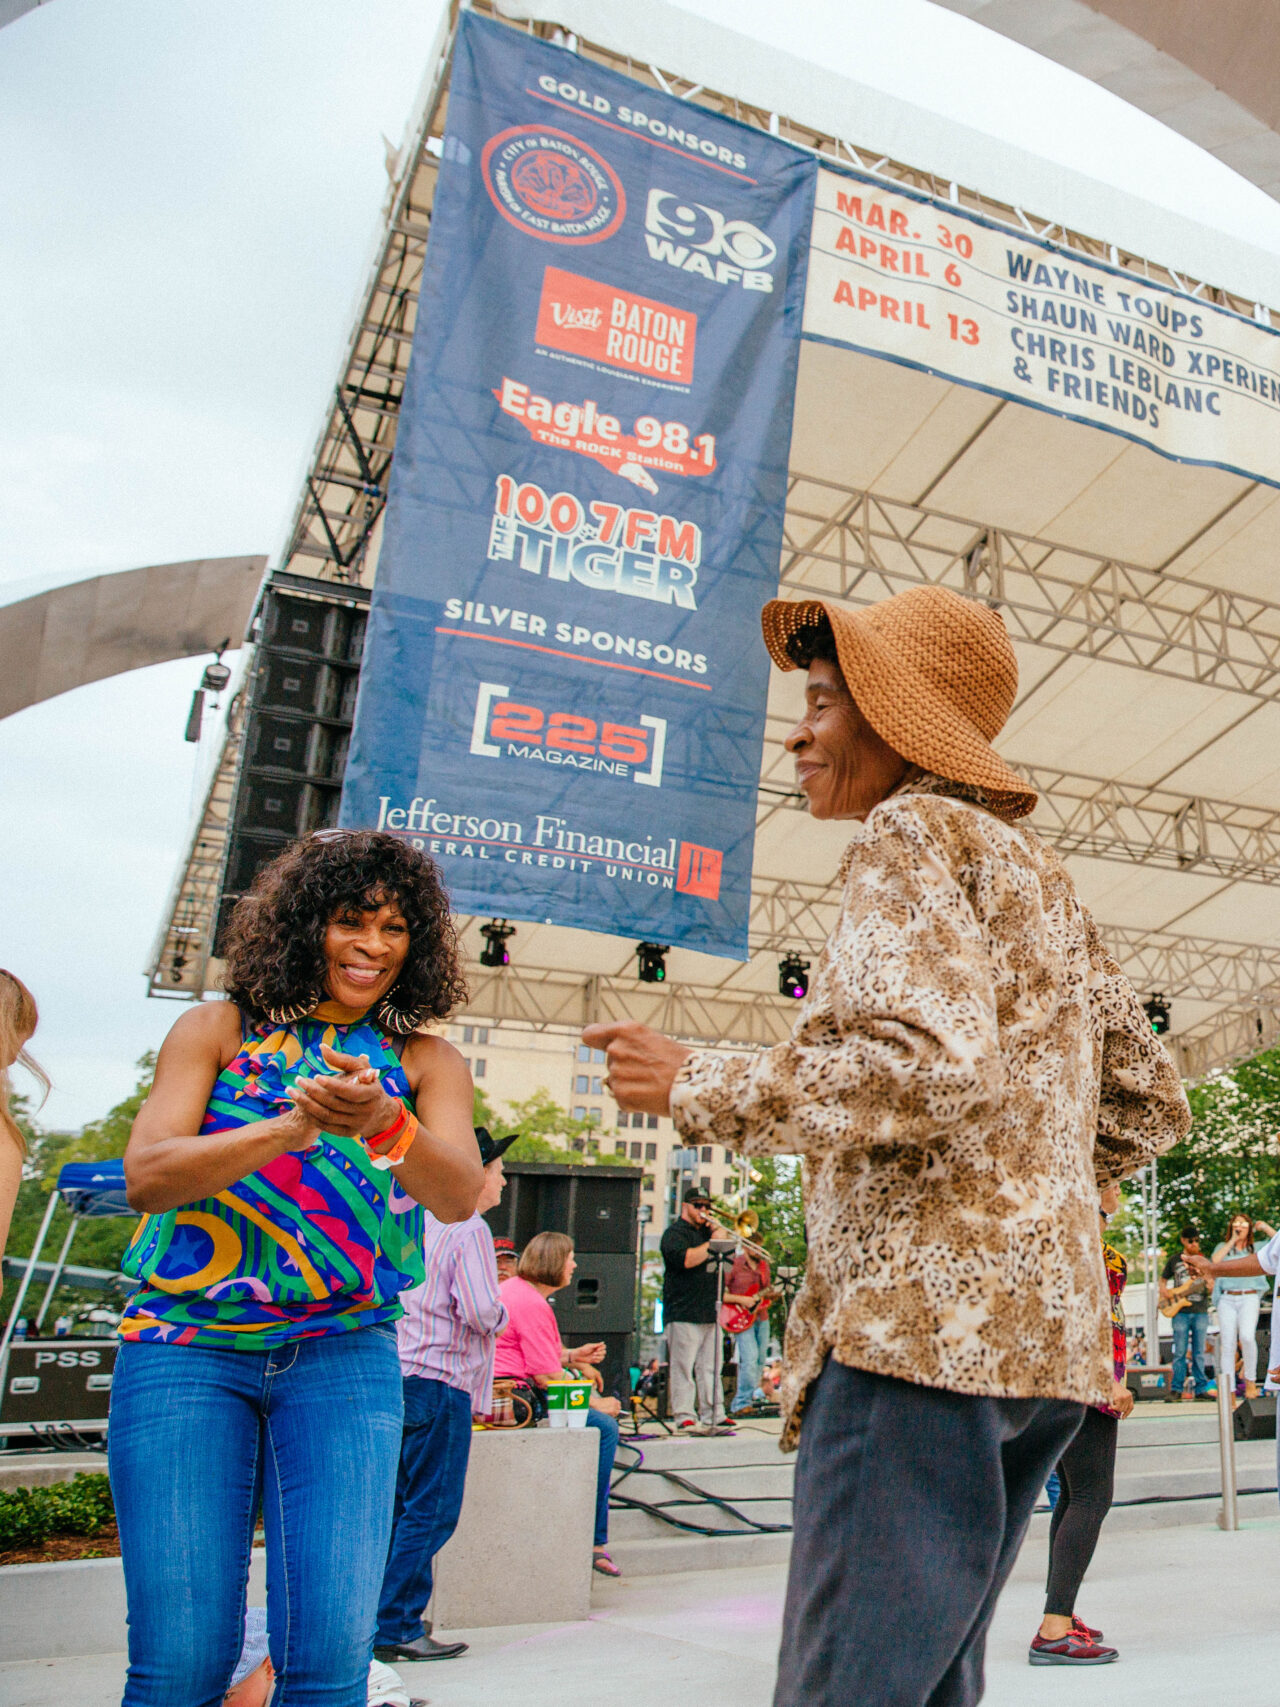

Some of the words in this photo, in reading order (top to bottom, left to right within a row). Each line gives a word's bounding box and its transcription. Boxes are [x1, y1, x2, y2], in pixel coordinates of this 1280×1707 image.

[502, 140, 525, 160] CITY
[540, 137, 578, 159] BATON
[538, 75, 611, 114] GOLD
[617, 105, 747, 170] SPONSORS
[521, 210, 550, 229] EAST
[836, 191, 921, 239] MAR.
[937, 223, 974, 260] 30
[644, 233, 774, 293] WAFB
[835, 226, 930, 278] APRIL
[943, 263, 962, 287] 6
[551, 302, 604, 331] Visit
[611, 298, 687, 347] BATON
[833, 280, 931, 331] APRIL
[947, 312, 980, 346] 13
[1006, 249, 1106, 307] WAYNE
[1117, 291, 1204, 338] TOUPS
[606, 328, 684, 376] ROUGE
[1006, 290, 1098, 336] SHAUN
[1106, 319, 1176, 368] WARD
[549, 351, 595, 370] AUTHENTIC
[1011, 327, 1096, 371] CHRIS
[1109, 353, 1222, 417] LEBLANC
[500, 377, 622, 441] Eagle
[633, 416, 716, 467] 98.1
[1013, 356, 1033, 384] &
[1048, 367, 1160, 429] FRIENDS
[538, 430, 570, 446] The
[626, 449, 684, 472] Station
[487, 514, 516, 561] THE
[514, 519, 698, 611] TIGER
[444, 598, 548, 637] SILVER
[554, 622, 708, 674] SPONSORS
[508, 743, 629, 777] MAGAZINE
[378, 796, 523, 844] Jefferson
[533, 814, 678, 871] Financial
[410, 838, 490, 860] DERAL
[505, 848, 593, 873] CREDIT
[606, 864, 674, 890] UNION
[35, 1350, 102, 1369] PSS
